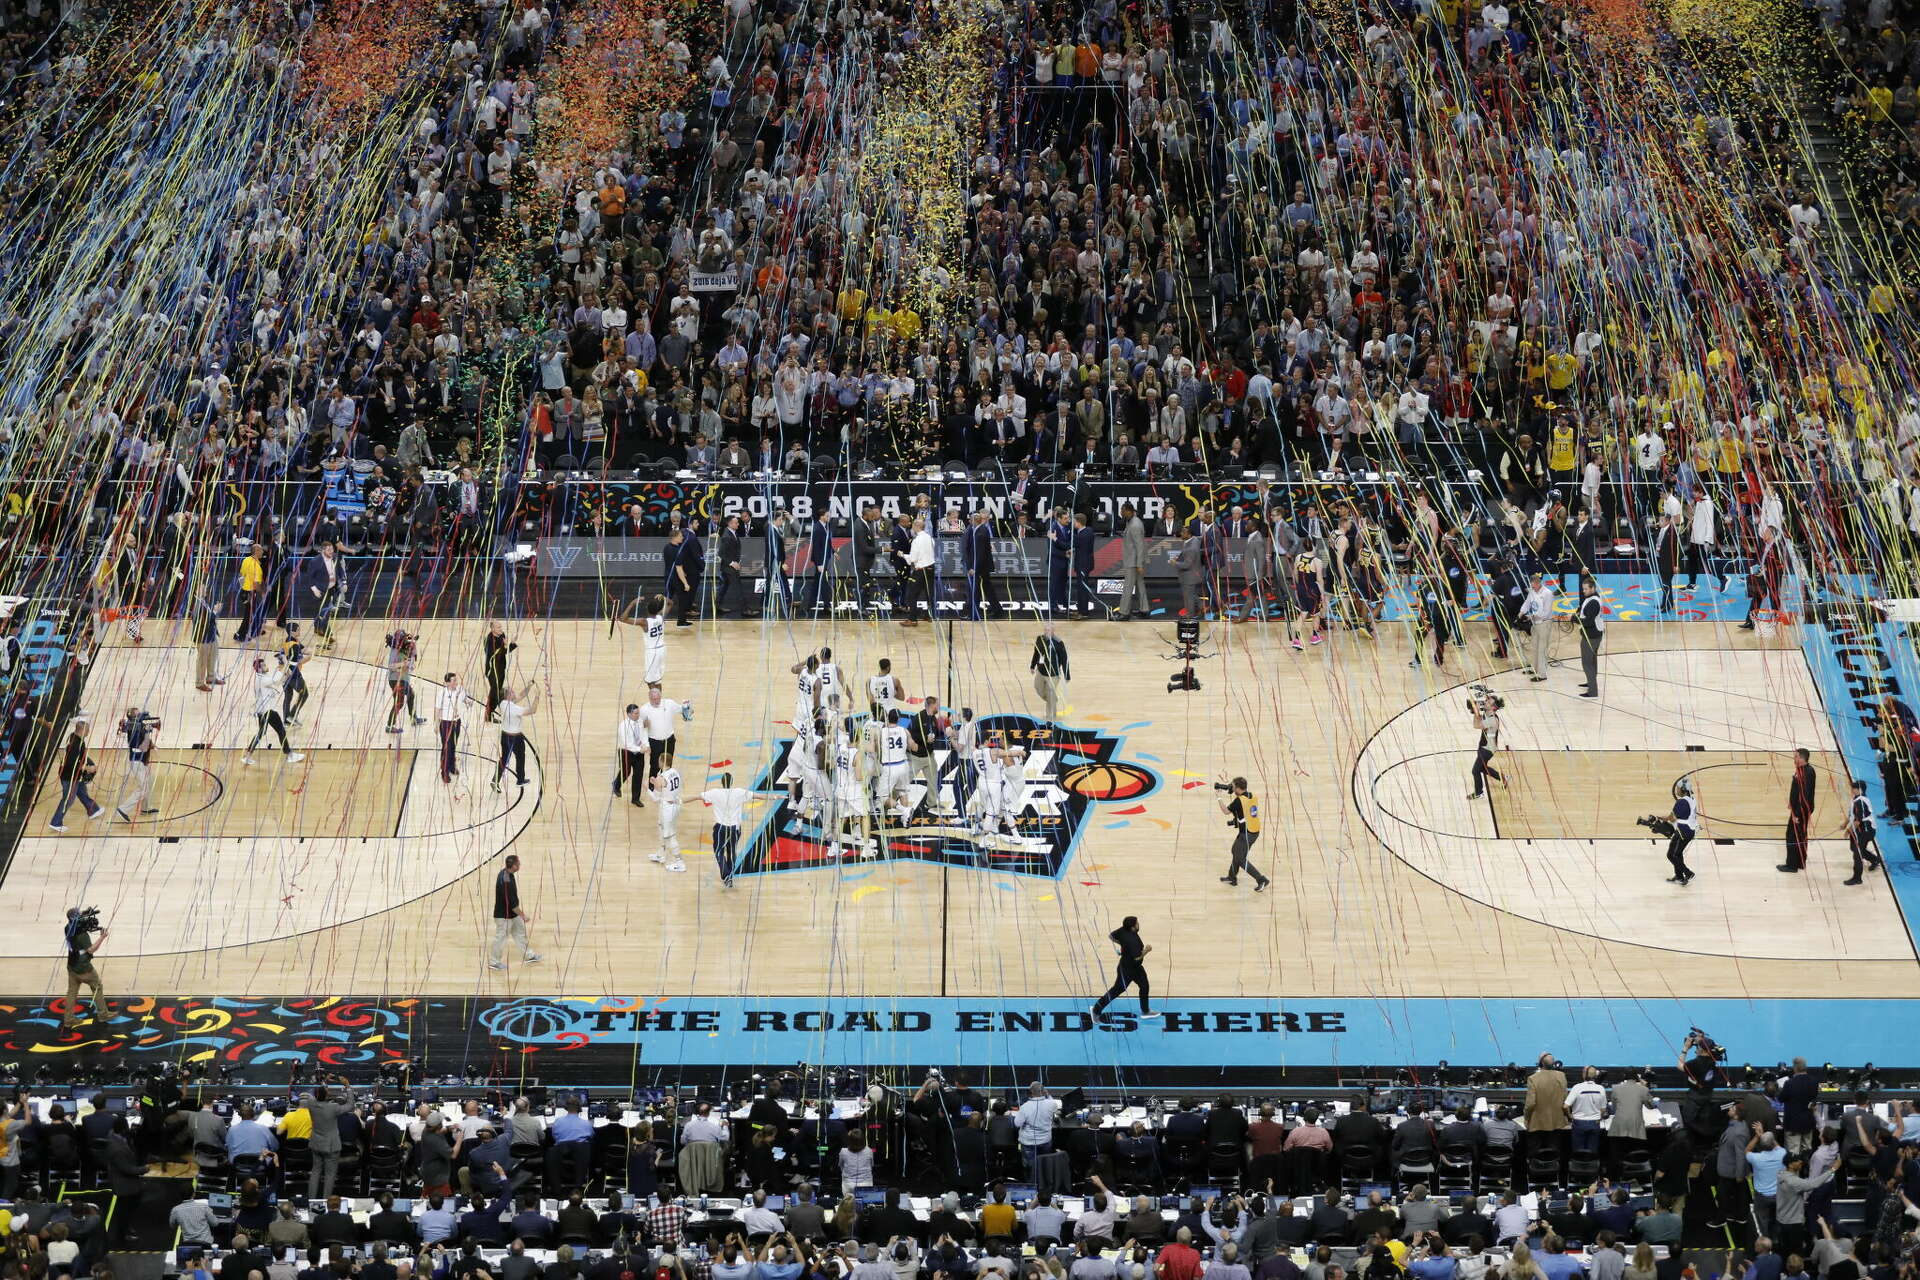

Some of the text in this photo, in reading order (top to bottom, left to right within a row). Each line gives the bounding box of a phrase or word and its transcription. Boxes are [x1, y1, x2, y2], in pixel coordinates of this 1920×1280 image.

[1642, 443, 1651, 458] 4
[828, 496, 926, 518] NCA
[943, 496, 1053, 519] FINL
[591, 552, 670, 562] VILLANO
[822, 672, 831, 685] 5
[887, 736, 903, 750] 34
[670, 776, 680, 792] 10
[583, 1011, 1347, 1033] THE ROAD ENDS HERE
